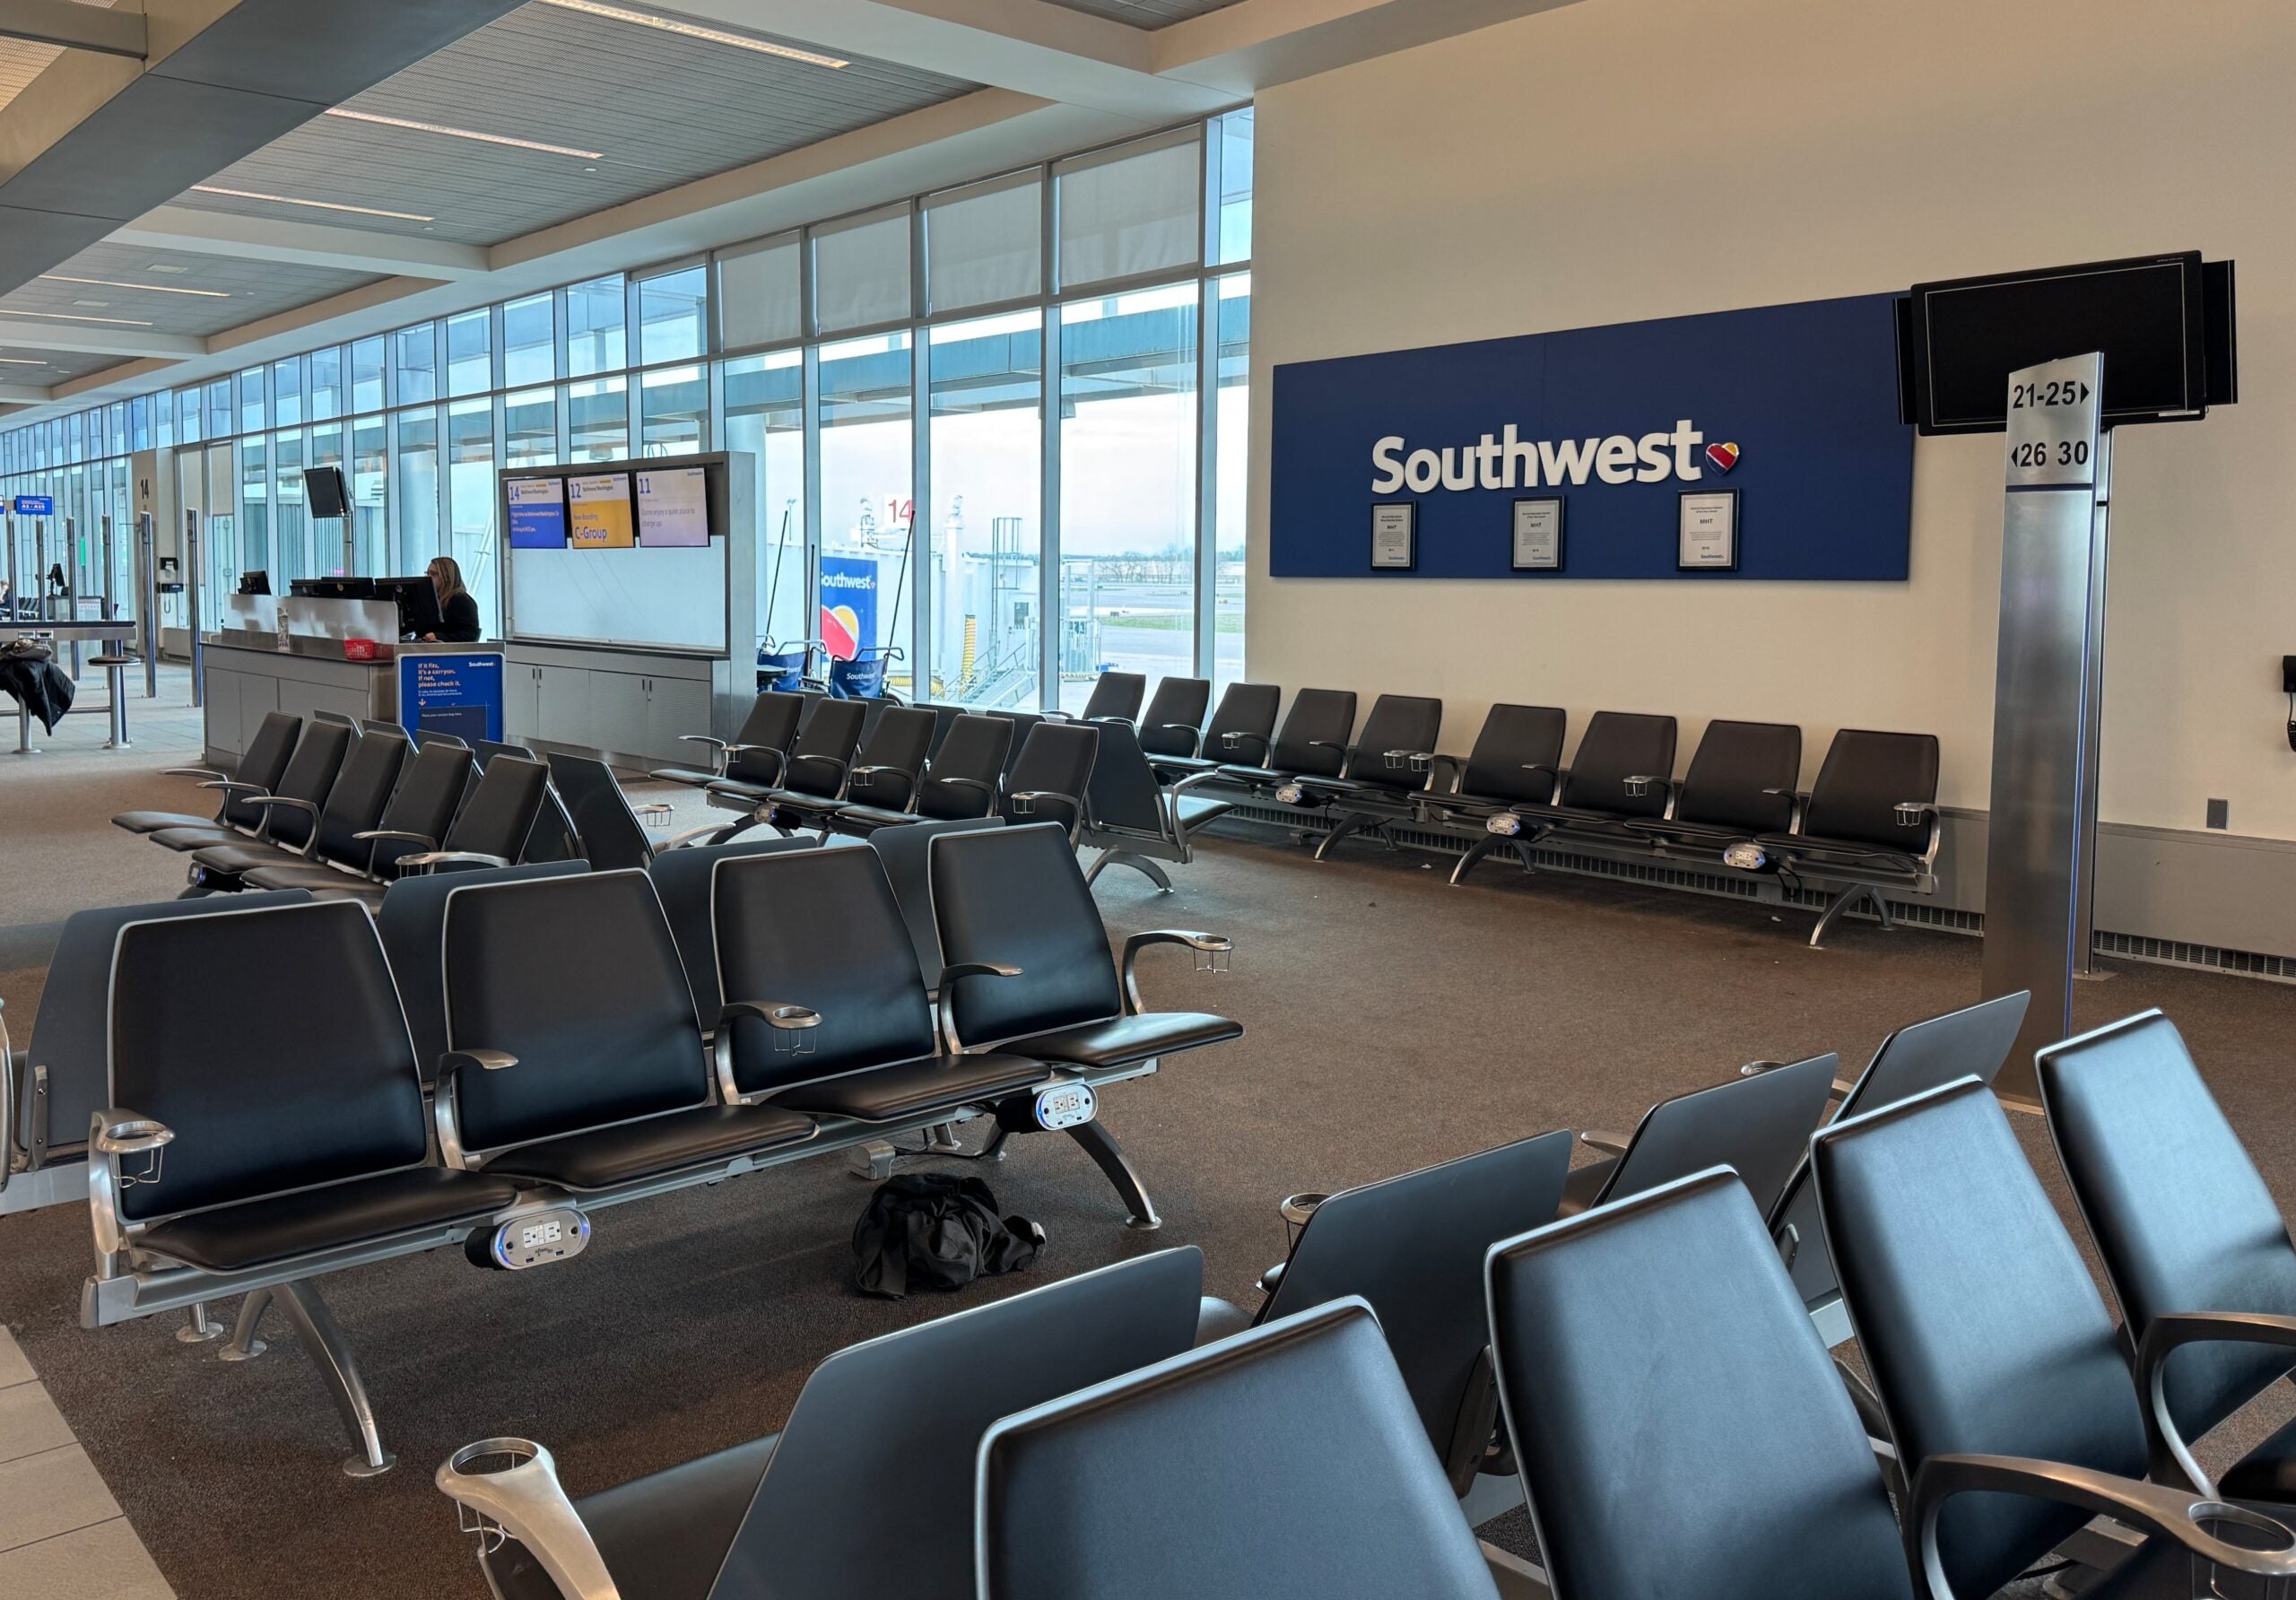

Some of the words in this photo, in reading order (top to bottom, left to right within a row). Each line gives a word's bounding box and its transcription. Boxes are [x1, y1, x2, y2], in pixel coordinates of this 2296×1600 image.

[2013, 380, 2076, 409] 21-25
[1371, 419, 1704, 495] Southwest
[2019, 442, 2047, 467] 26
[2057, 440, 2089, 466] 30
[140, 478, 149, 500] 14
[509, 485, 520, 501] 14
[570, 483, 582, 499] 12
[639, 478, 651, 494] 11
[888, 500, 914, 524] 14
